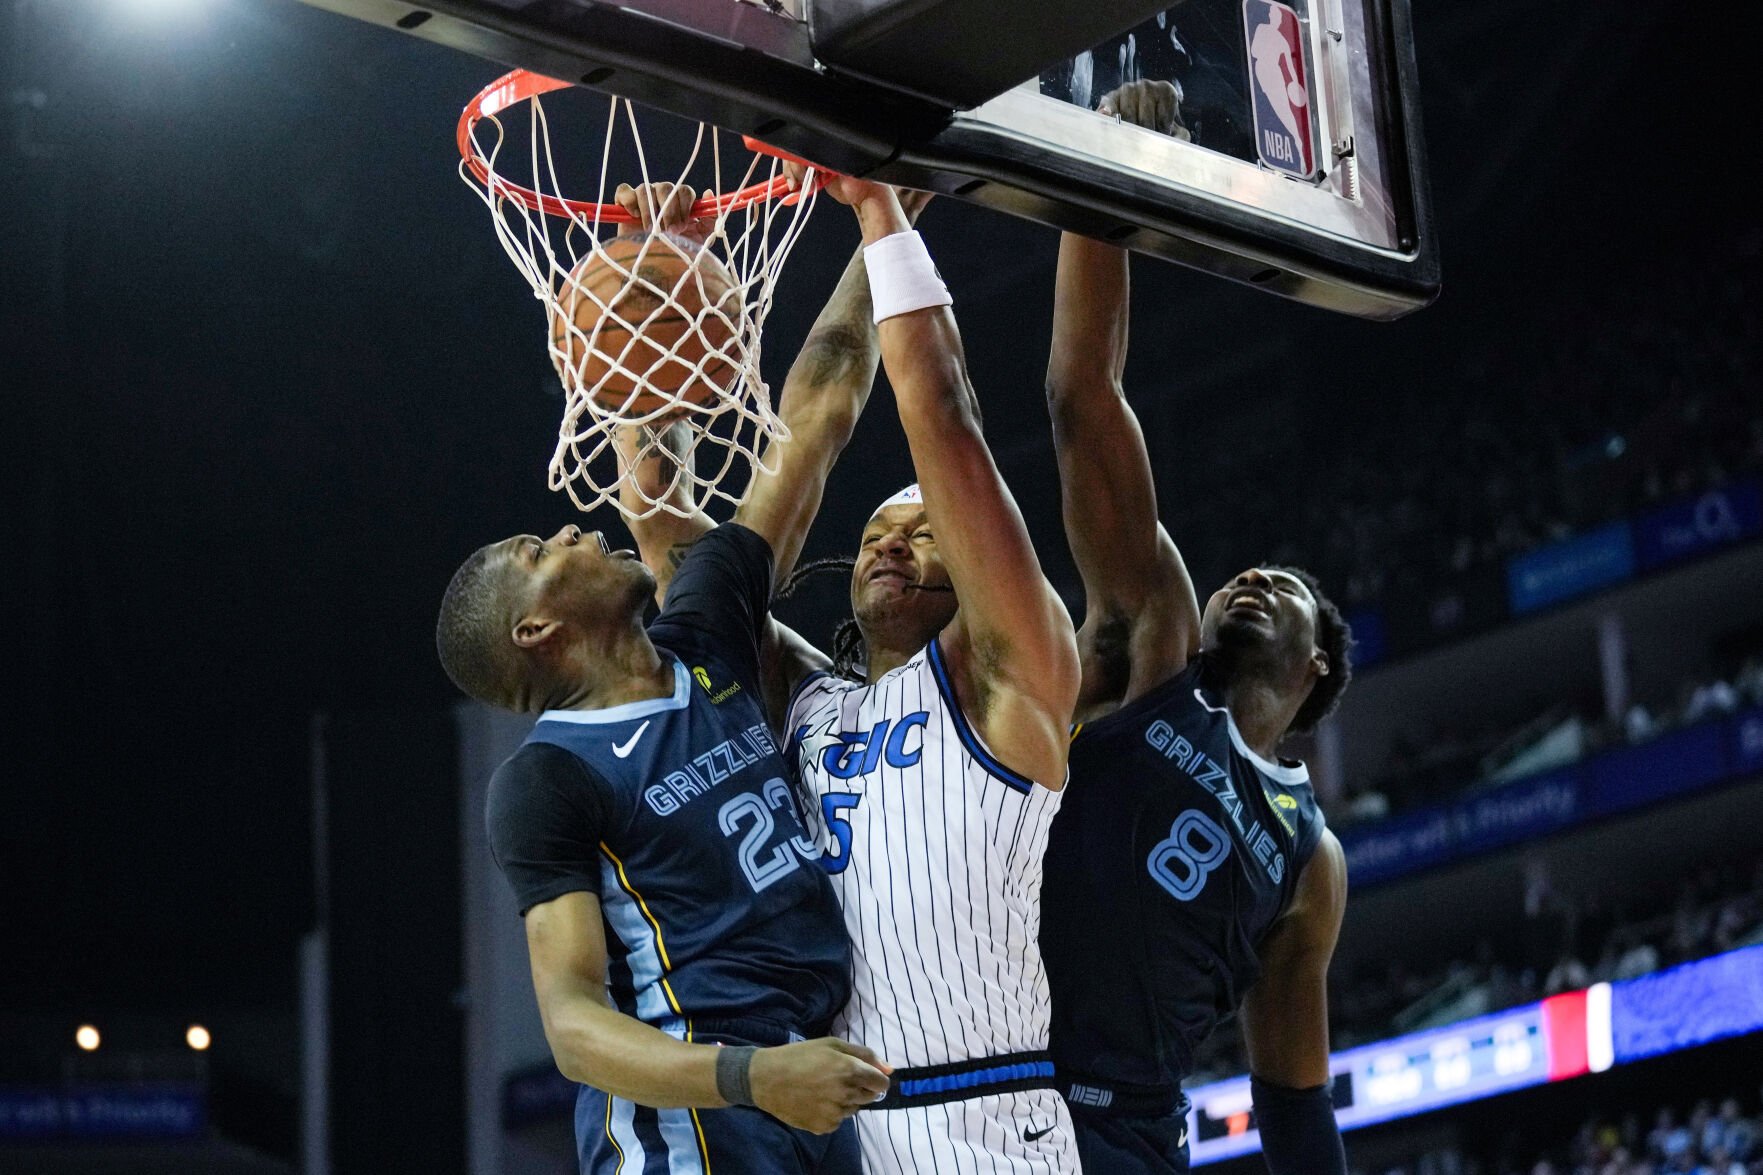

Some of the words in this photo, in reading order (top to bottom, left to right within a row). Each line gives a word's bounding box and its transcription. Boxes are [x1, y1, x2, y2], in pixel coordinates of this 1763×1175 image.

[1264, 129, 1294, 163] NBA
[820, 791, 862, 875] 5
[1145, 719, 1287, 885] GRIZZLIES
[1146, 808, 1232, 902] 8
